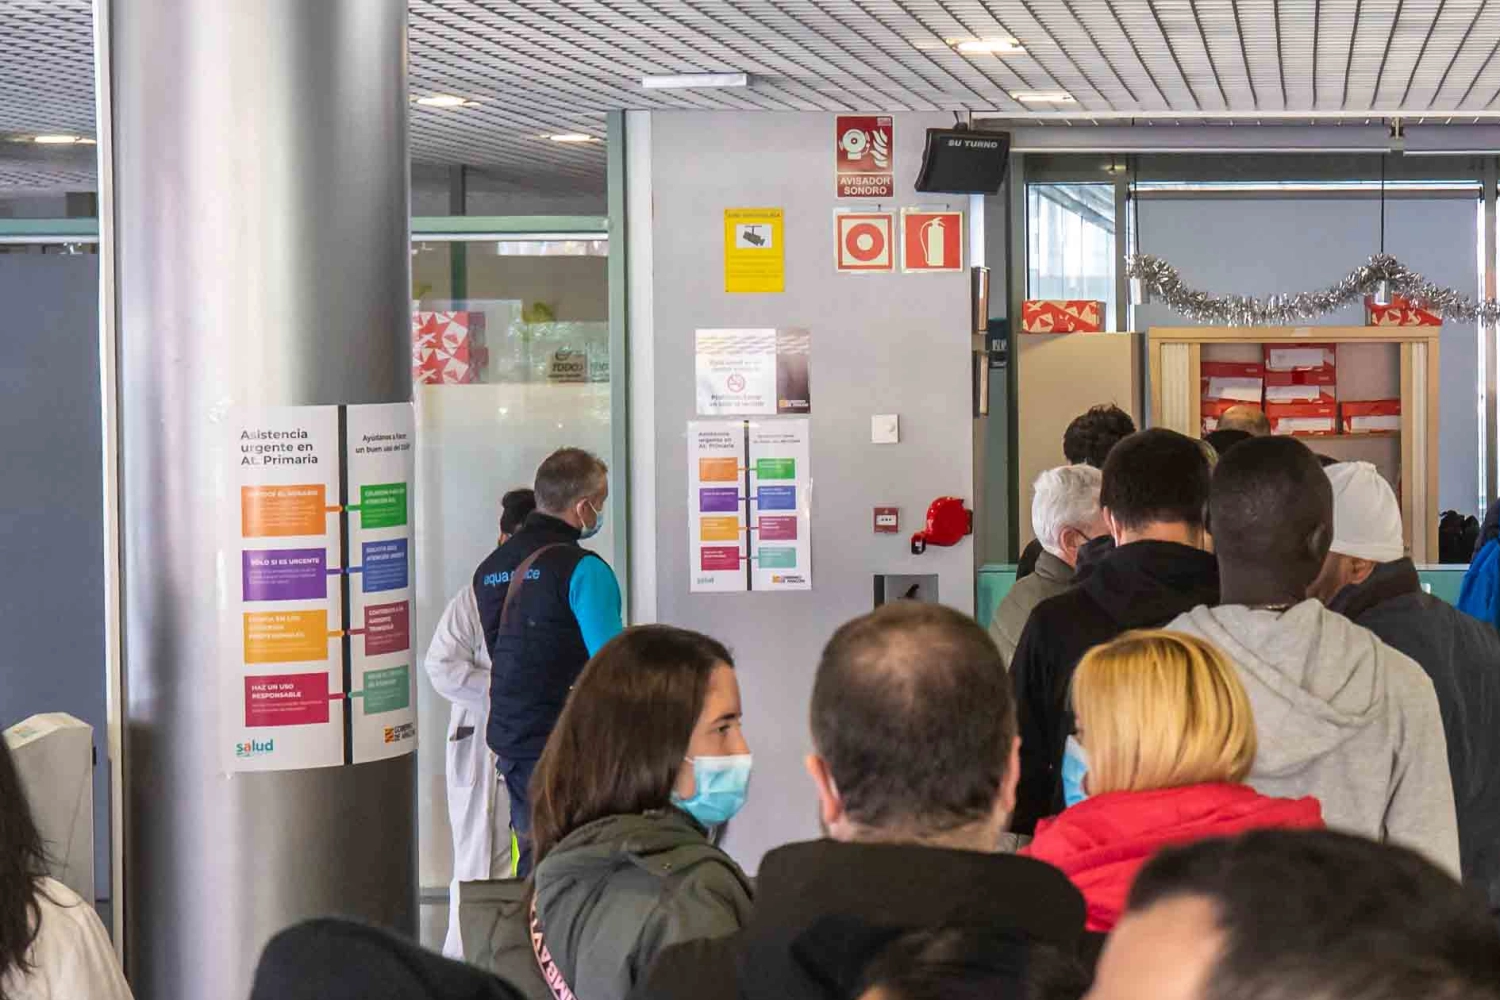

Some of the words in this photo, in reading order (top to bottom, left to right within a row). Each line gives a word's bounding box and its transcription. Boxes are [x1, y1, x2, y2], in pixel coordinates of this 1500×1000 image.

[949, 139, 962, 147] SU
[964, 140, 998, 149] TURNO
[840, 176, 891, 185] AVISADOR
[843, 186, 888, 195] SONORO
[240, 428, 308, 440] Asistencia
[241, 442, 293, 454] urgente
[297, 443, 313, 452] en
[263, 453, 319, 465] Primaria
[251, 691, 302, 699] RESPONSABLE
[236, 738, 274, 752] salud
